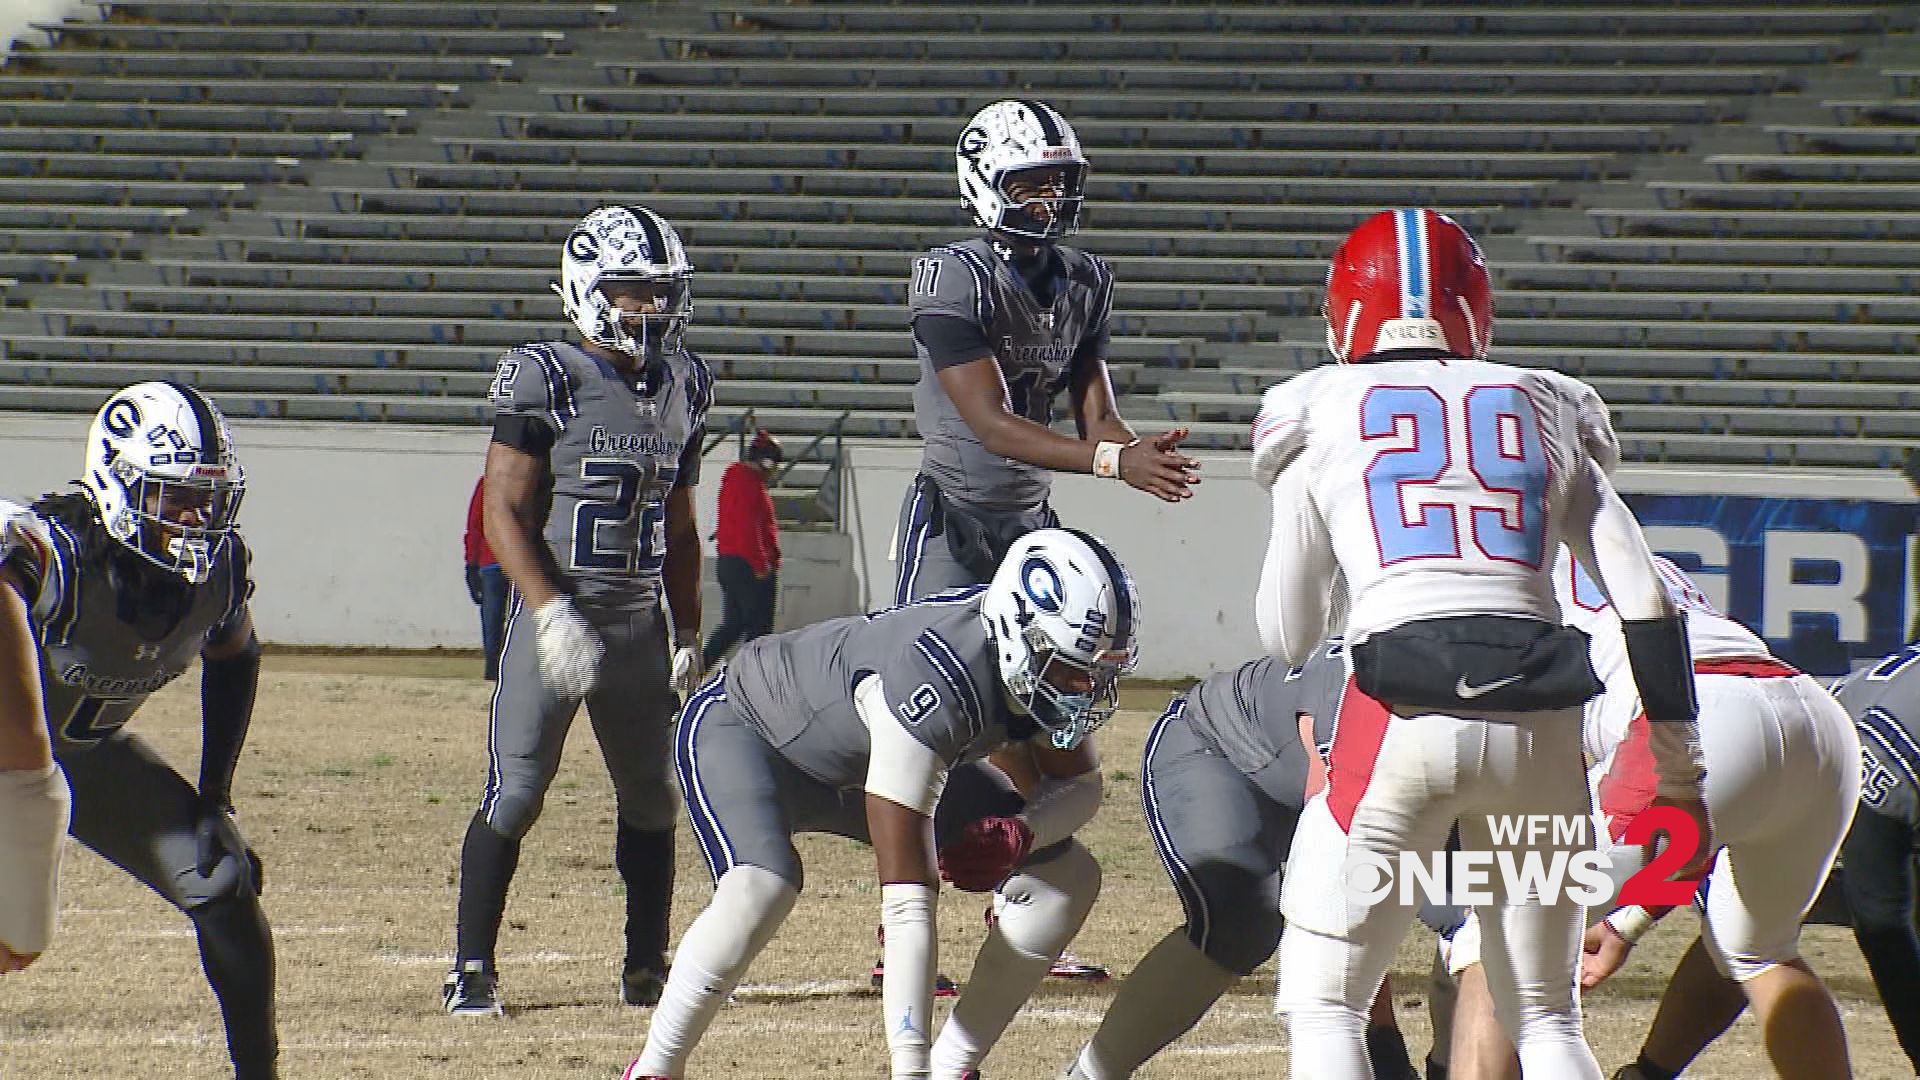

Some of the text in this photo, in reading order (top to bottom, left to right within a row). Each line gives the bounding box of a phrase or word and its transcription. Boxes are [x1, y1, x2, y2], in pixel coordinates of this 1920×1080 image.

[567, 228, 600, 262] G
[914, 257, 942, 297] 11
[1359, 384, 1553, 573] 29
[1020, 554, 1066, 613] G
[898, 683, 941, 736] 9
